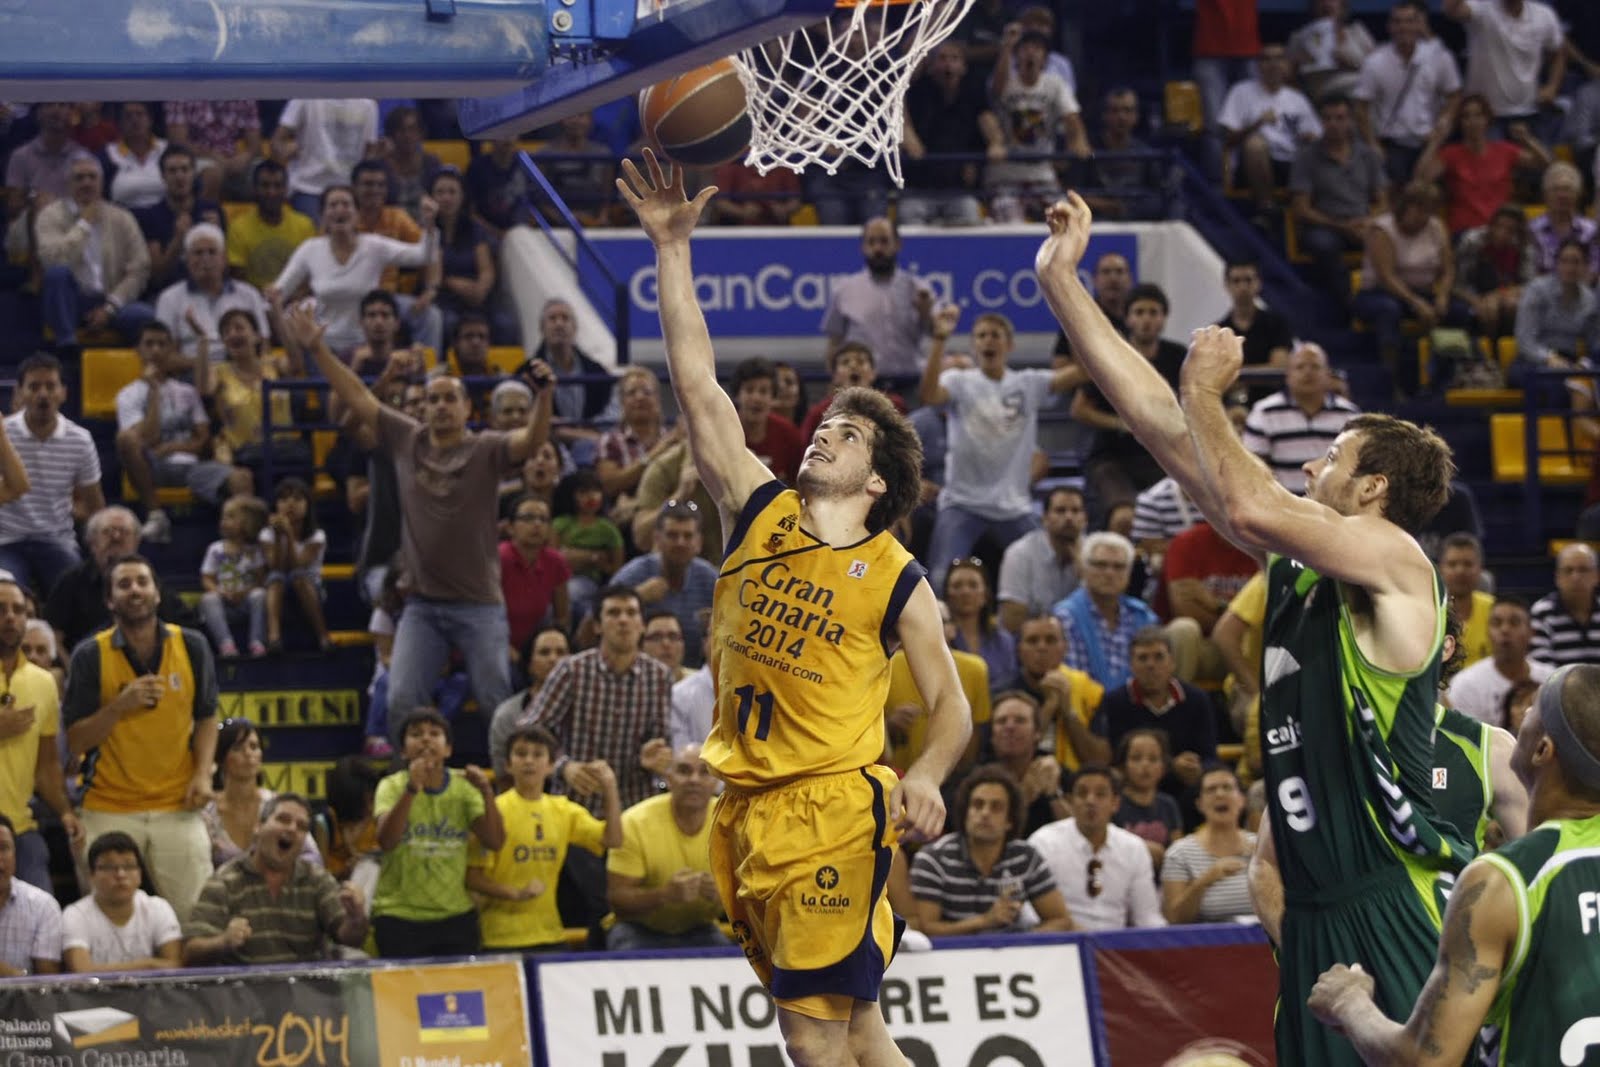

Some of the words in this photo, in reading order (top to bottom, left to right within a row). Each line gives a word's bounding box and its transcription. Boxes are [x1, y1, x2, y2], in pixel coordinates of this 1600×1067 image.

[760, 562, 834, 609] Gran
[739, 579, 845, 646] Canaria
[725, 633, 824, 684] GranCanariacom
[745, 619, 806, 660] 2014
[734, 684, 775, 742] 11
[1278, 776, 1316, 832] 9
[801, 893, 816, 906] La
[820, 893, 850, 907] Caja
[593, 985, 665, 1036] MI
[691, 978, 950, 1031] NORE
[976, 973, 1042, 1021] ES
[8, 1051, 74, 1067] Gran
[82, 1046, 189, 1067] Canaria
[252, 1012, 351, 1067] 2014
